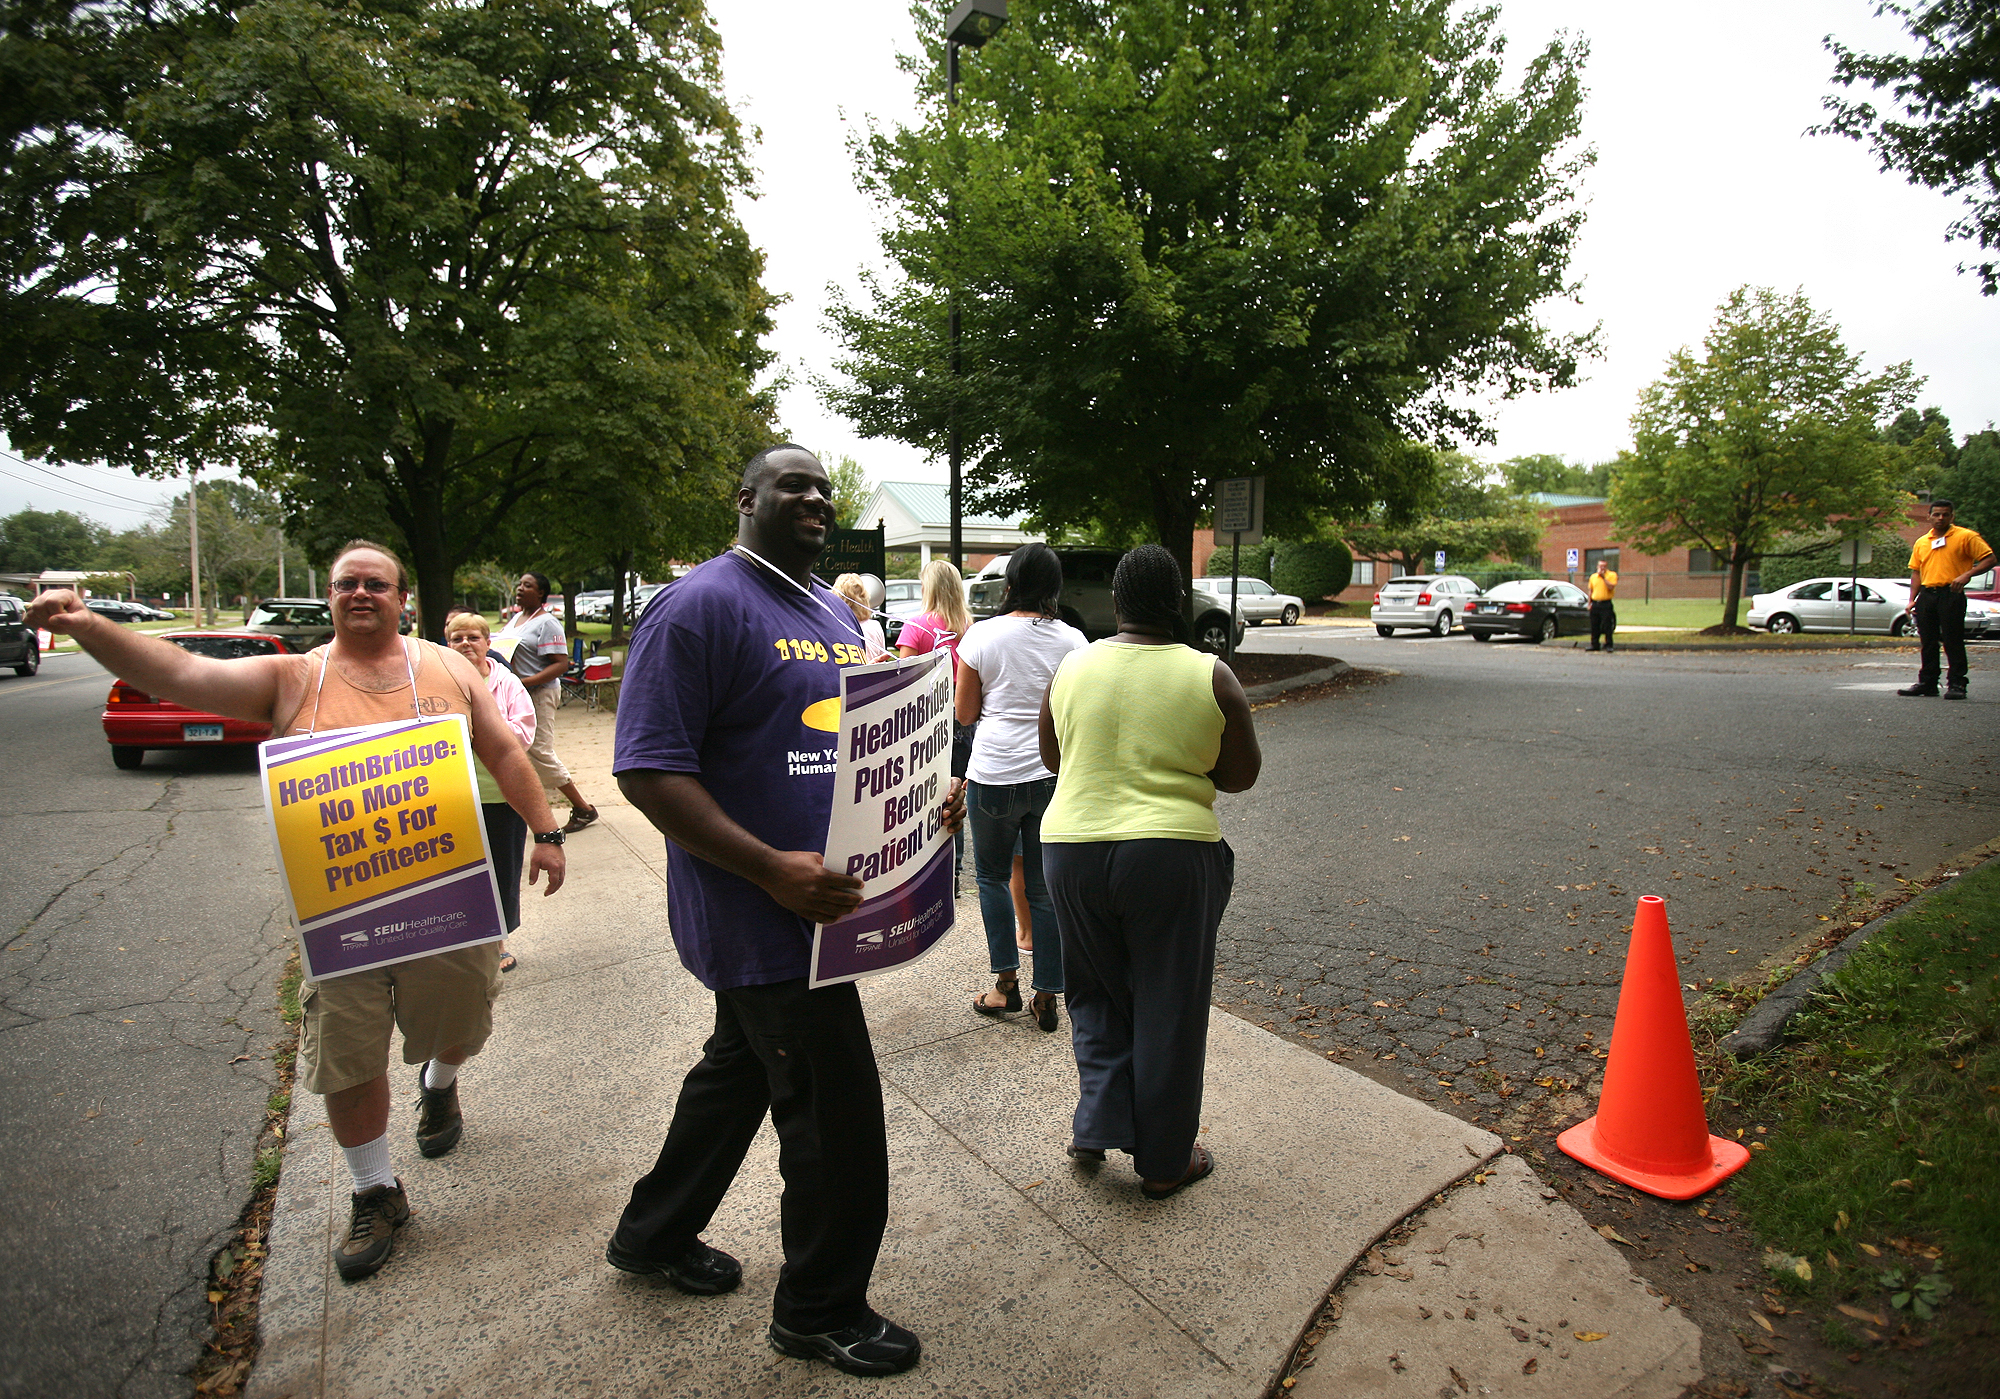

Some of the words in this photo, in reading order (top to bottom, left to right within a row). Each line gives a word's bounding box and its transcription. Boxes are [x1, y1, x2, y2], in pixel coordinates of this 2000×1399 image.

[824, 556, 861, 571] Center
[840, 539, 875, 553] Health
[774, 638, 829, 664] 1199
[849, 676, 949, 763] HealthBridge
[278, 739, 457, 807] HealthBridge:
[787, 751, 821, 763] New
[854, 754, 904, 804] Puts
[909, 718, 949, 776] Profits
[319, 799, 355, 828] No
[362, 775, 430, 814] More
[883, 772, 938, 834] Before
[320, 827, 368, 860] Tax
[373, 816, 392, 845] $
[398, 804, 438, 836] For
[846, 818, 924, 882] Patient
[325, 832, 455, 893] Profiteers
[375, 935, 404, 946] United
[405, 931, 417, 940] for
[418, 925, 448, 937] Quality
[449, 920, 468, 931] Care
[888, 931, 912, 949] United
[912, 927, 921, 939] for
